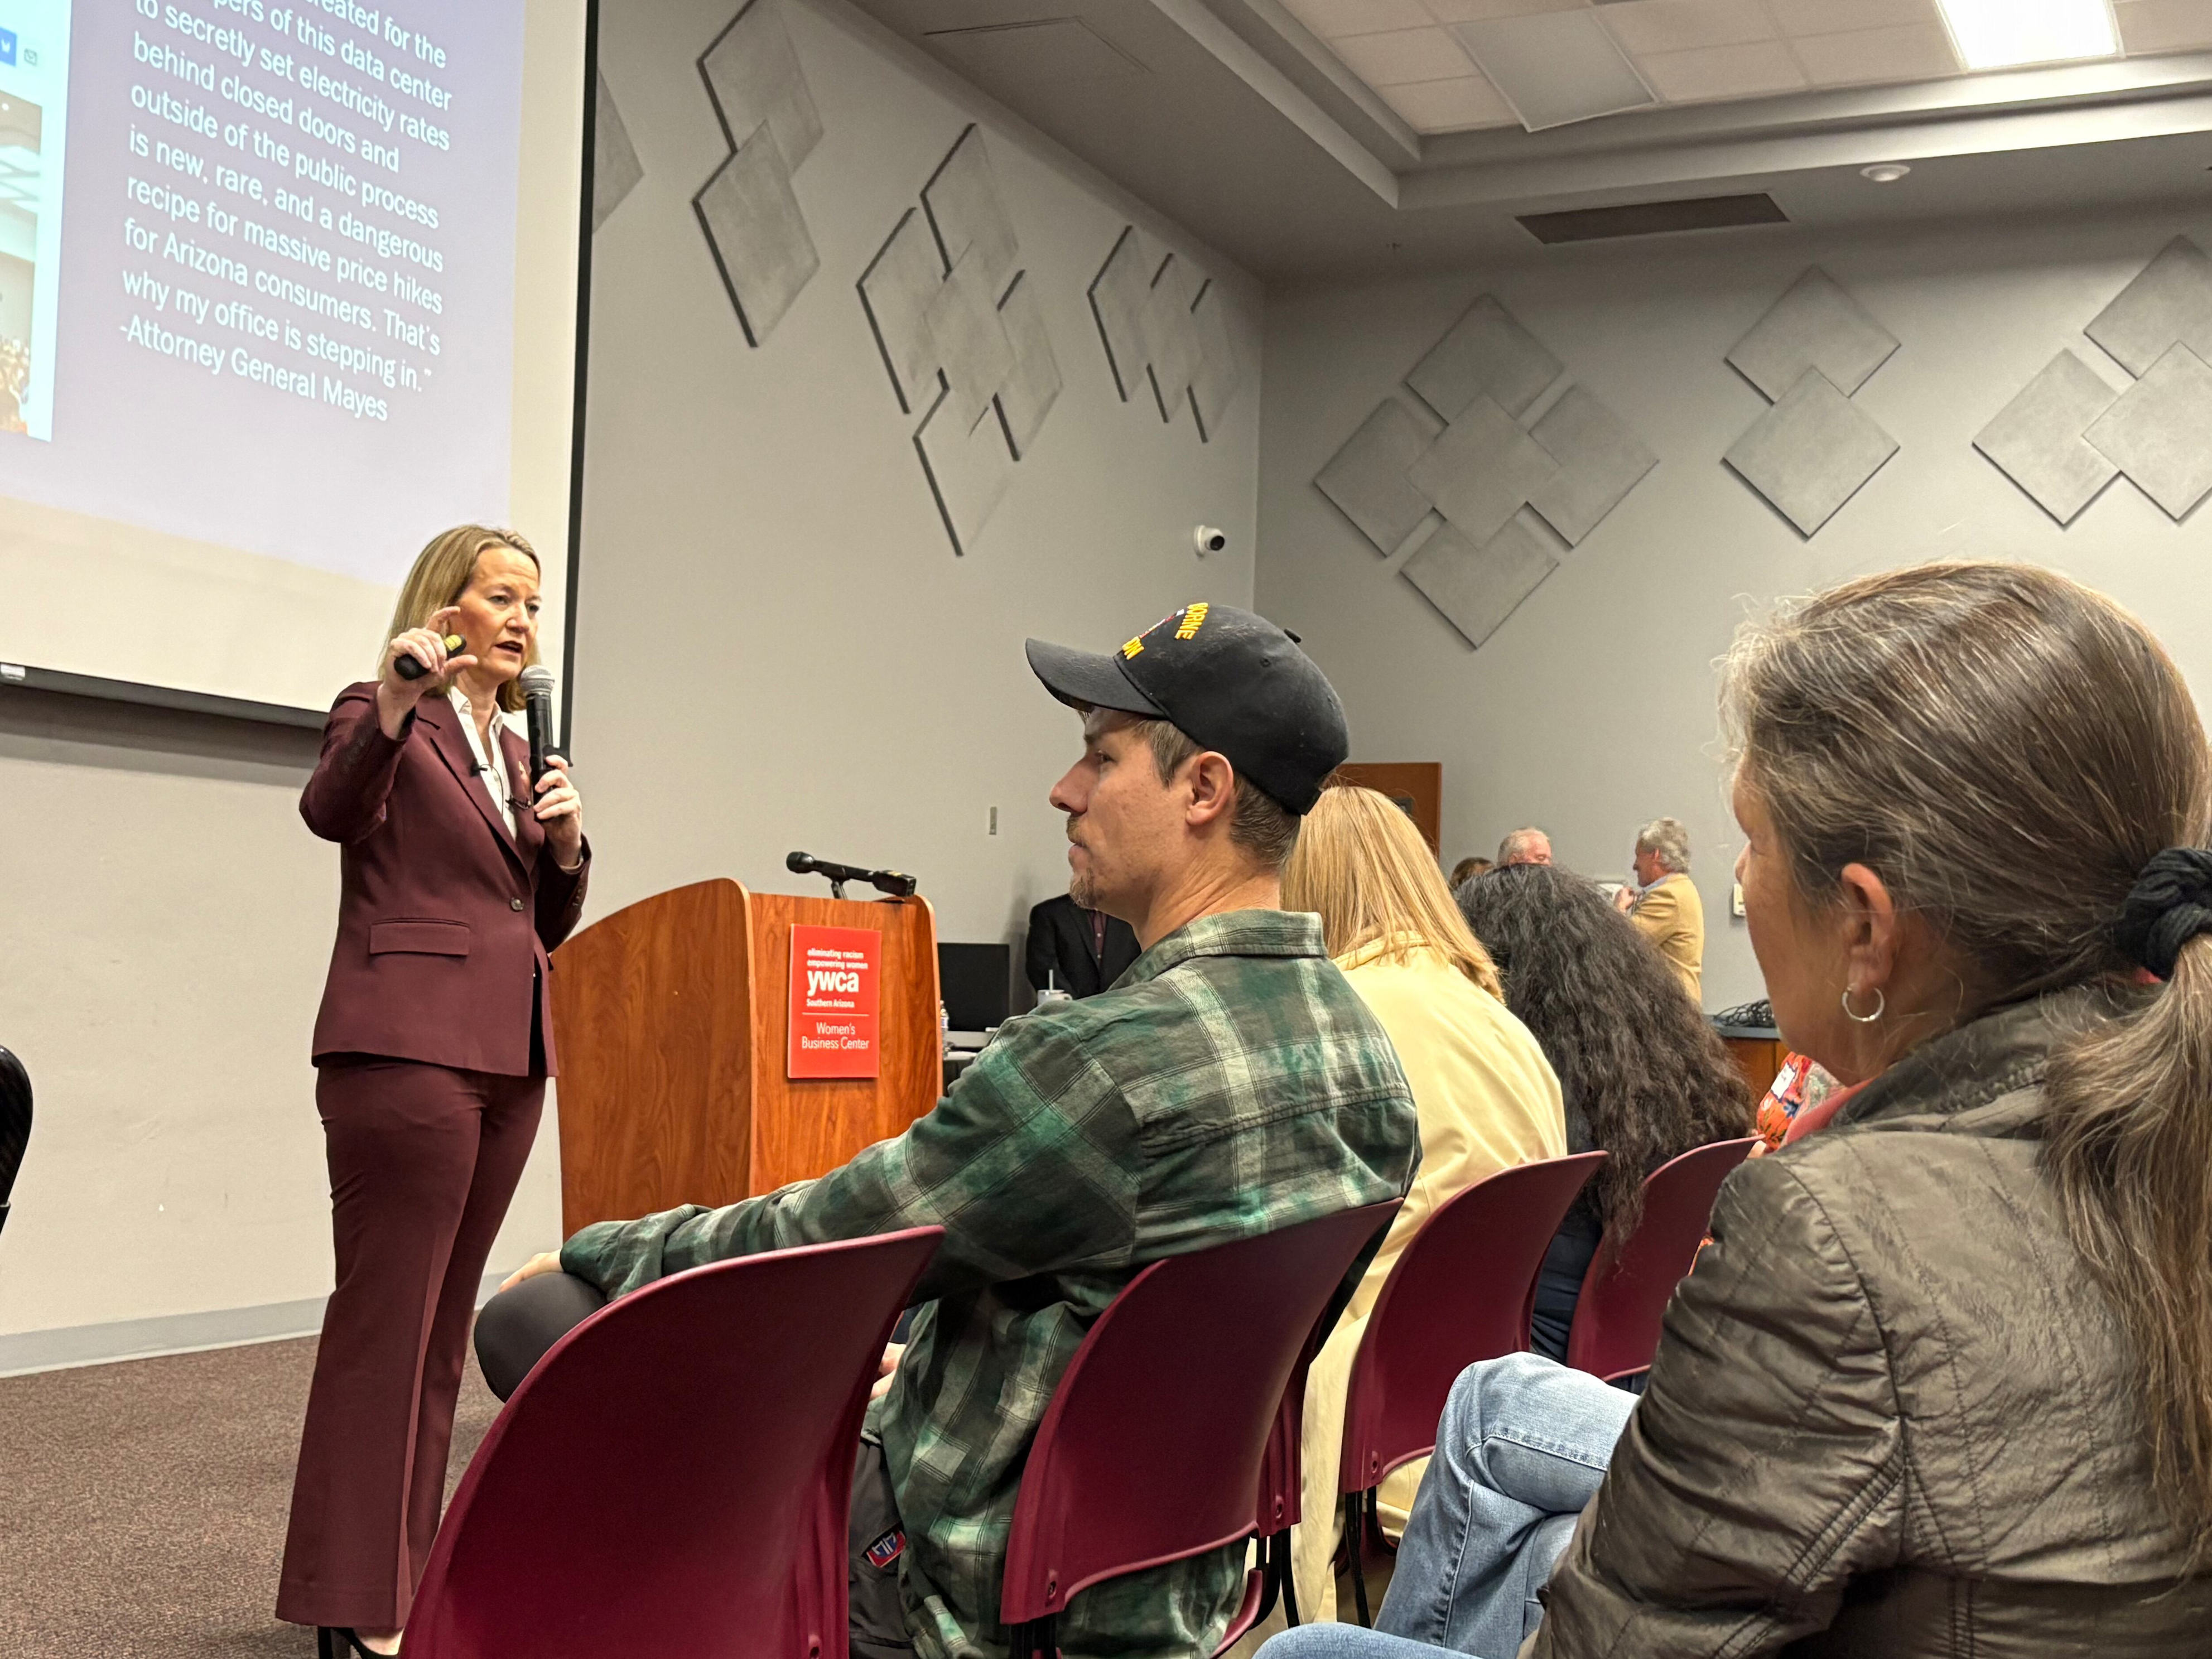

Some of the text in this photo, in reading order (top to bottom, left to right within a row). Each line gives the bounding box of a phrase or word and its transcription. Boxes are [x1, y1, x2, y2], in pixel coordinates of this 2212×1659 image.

[137, 0, 449, 151] to secretly set electricity rates
[271, 8, 293, 35] of
[297, 16, 335, 56] this
[341, 39, 384, 81] data
[390, 67, 452, 110] center
[384, 16, 410, 50] for
[415, 33, 446, 68] the
[134, 31, 398, 173] behind closed doors and
[130, 124, 148, 157] is
[156, 141, 208, 184] new,
[274, 187, 313, 222] and
[320, 208, 332, 230] a
[339, 211, 442, 272] dangerous
[131, 85, 438, 229] outside of the public process
[125, 218, 440, 355] for Arizona consumers. That's
[128, 177, 442, 314] recipe for massive price hikes
[120, 315, 387, 421] -Attorney General Mayes
[123, 271, 170, 311] why
[176, 289, 210, 324] my
[215, 302, 278, 341] office
[285, 319, 301, 350] is
[307, 333, 396, 388] stepping
[807, 948, 864, 959] eliminating racism
[807, 959, 868, 970] empowering women
[807, 970, 859, 996] ywca
[807, 999, 855, 1008] Southern Arizona
[802, 1036, 869, 1049] Business Center
[816, 1022, 855, 1035] Women's
